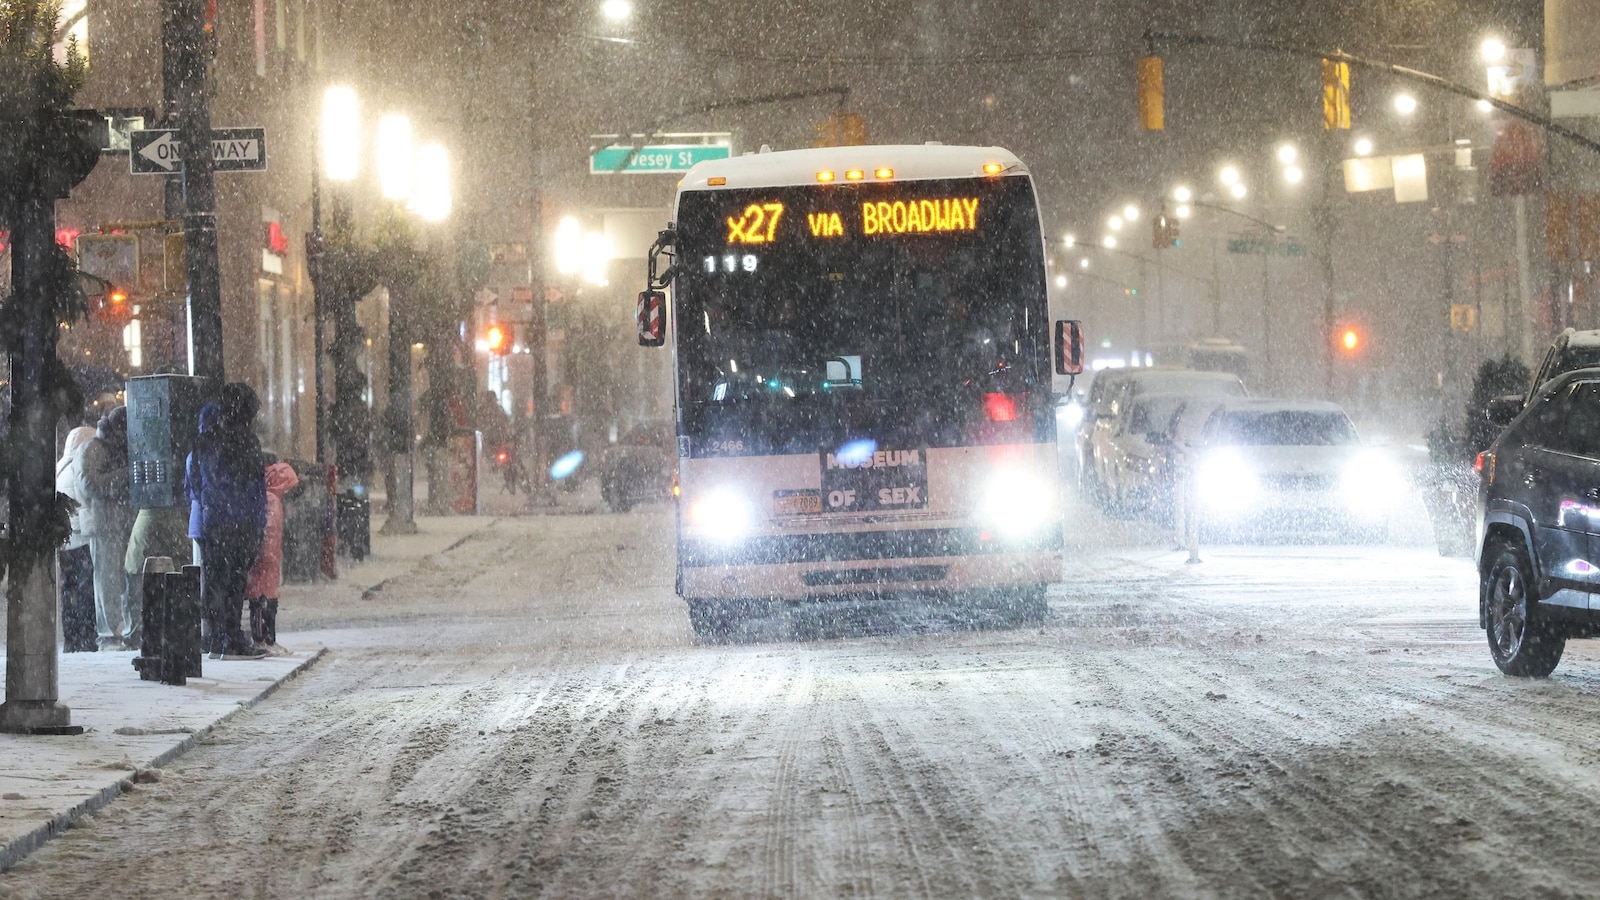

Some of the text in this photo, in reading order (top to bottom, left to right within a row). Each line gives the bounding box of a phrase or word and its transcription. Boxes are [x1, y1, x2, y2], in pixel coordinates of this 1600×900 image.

[157, 141, 250, 160] ON WAY
[630, 151, 693, 169] Vesey St
[807, 212, 844, 237] VIA
[863, 198, 979, 234] BROADWAY
[712, 440, 744, 452] 2466
[828, 486, 922, 507] OF SEX
